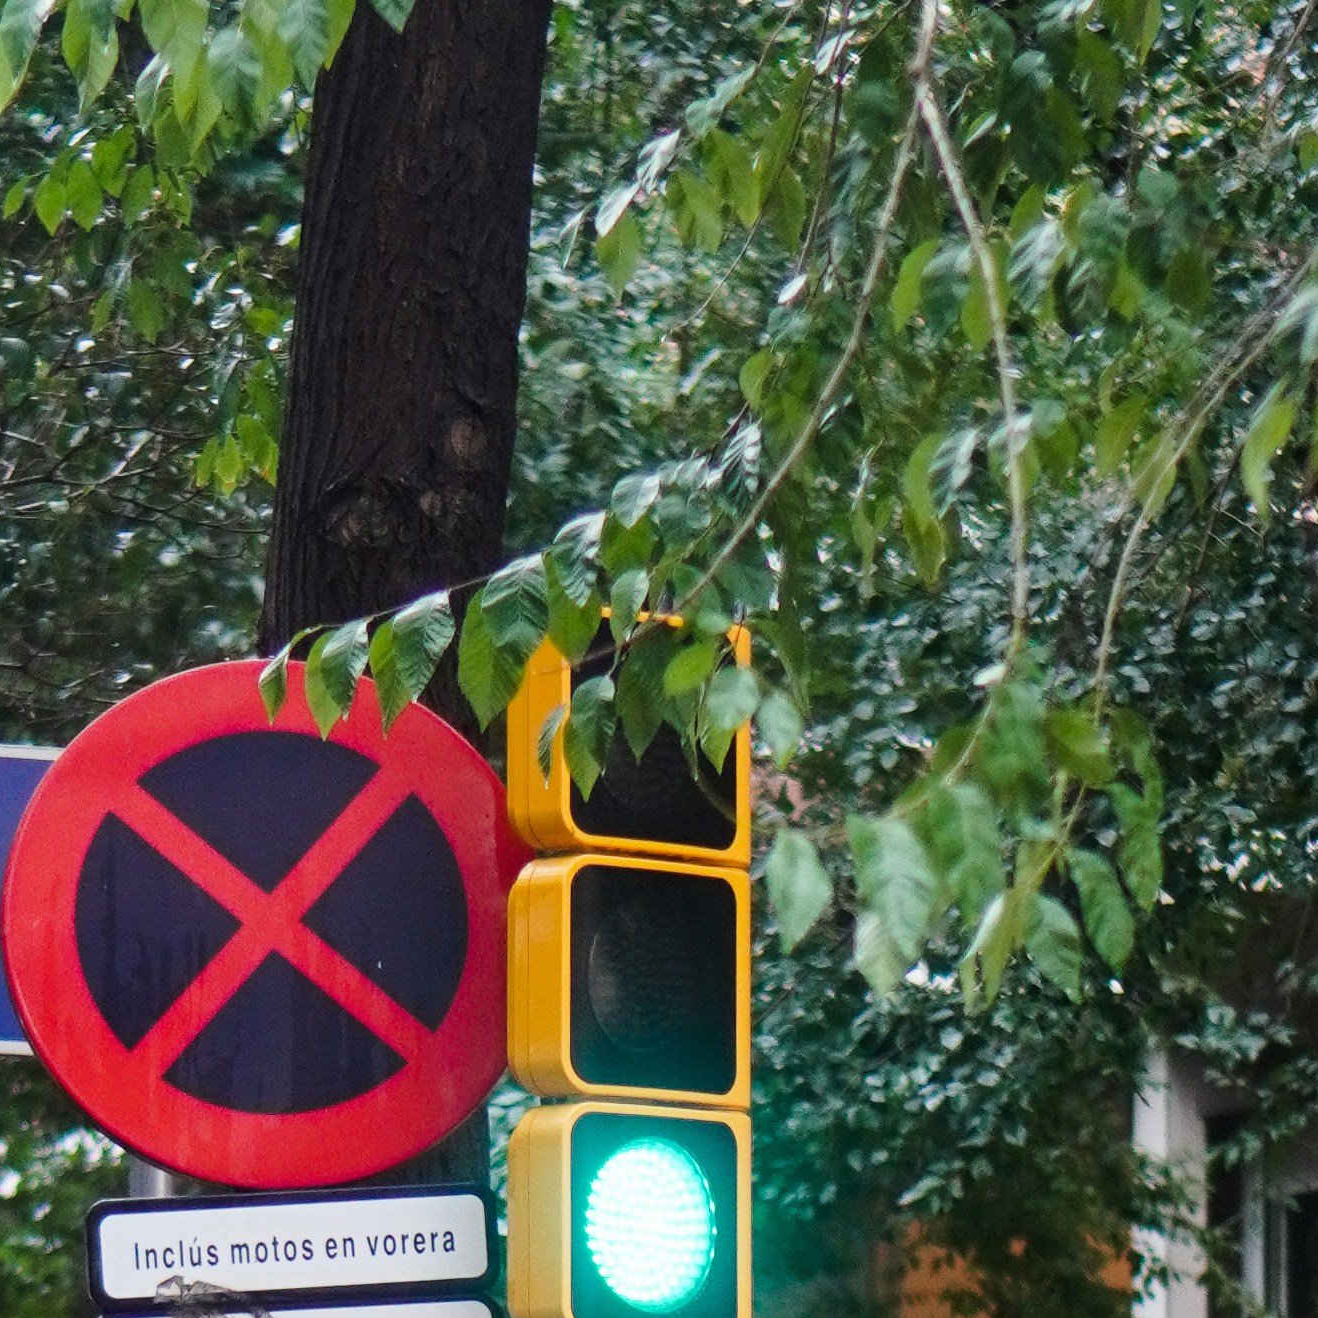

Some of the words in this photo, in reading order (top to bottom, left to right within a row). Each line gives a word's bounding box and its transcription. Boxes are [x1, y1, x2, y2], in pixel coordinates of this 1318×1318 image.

[134, 1236, 219, 1270] Inclús
[231, 1235, 314, 1265] motos
[326, 1236, 356, 1259] en
[366, 1230, 456, 1257] vorera
